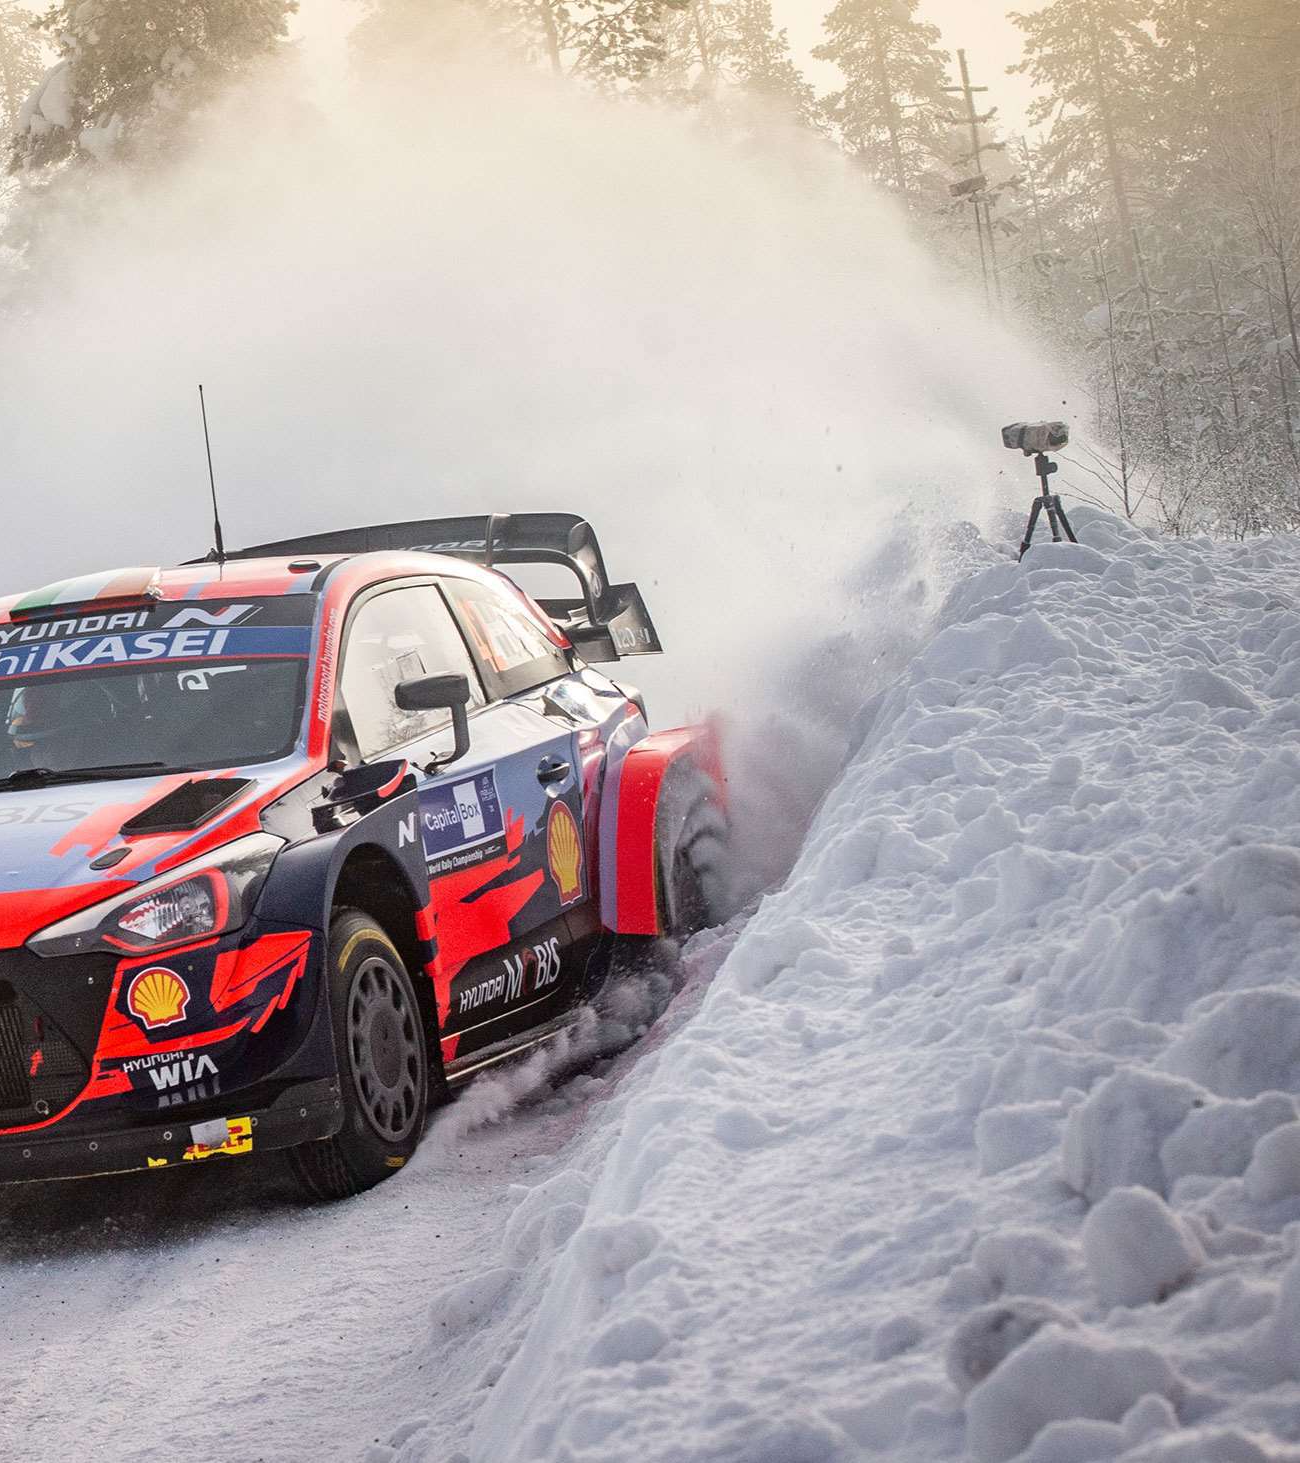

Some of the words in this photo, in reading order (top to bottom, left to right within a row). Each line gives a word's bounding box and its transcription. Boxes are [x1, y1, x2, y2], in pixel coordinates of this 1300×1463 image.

[459, 974, 506, 1014] HYUNDAI
[503, 937, 561, 1004] MOBIS
[122, 1051, 184, 1073] HYUNDAI
